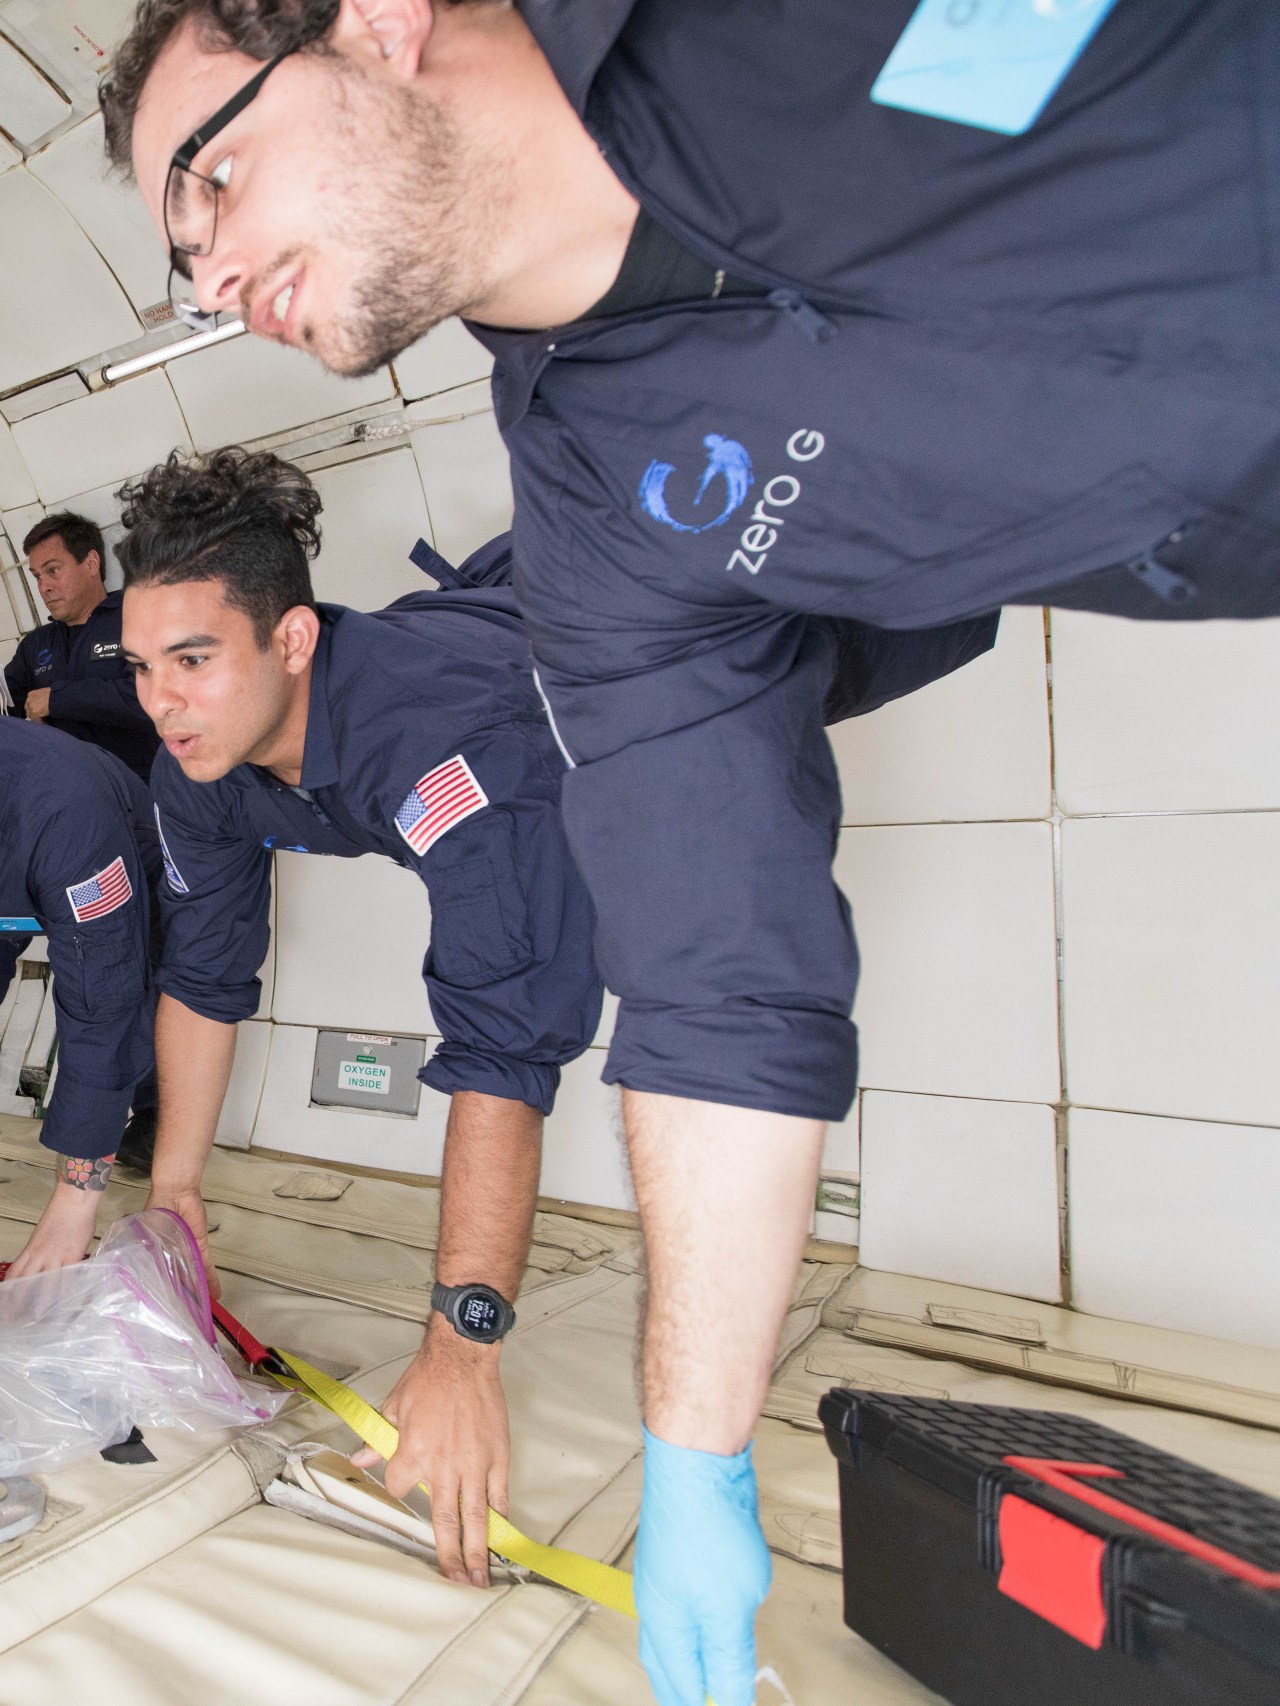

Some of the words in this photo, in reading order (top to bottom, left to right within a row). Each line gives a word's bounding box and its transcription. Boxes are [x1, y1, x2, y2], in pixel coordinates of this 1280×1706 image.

[144, 310, 155, 319] NO
[156, 304, 173, 315] HAN
[153, 311, 174, 323] HOLD
[725, 475, 801, 575] zero
[786, 428, 825, 462] G
[344, 1064, 386, 1077] OXYGEN
[348, 1077, 382, 1089] INSIDE
